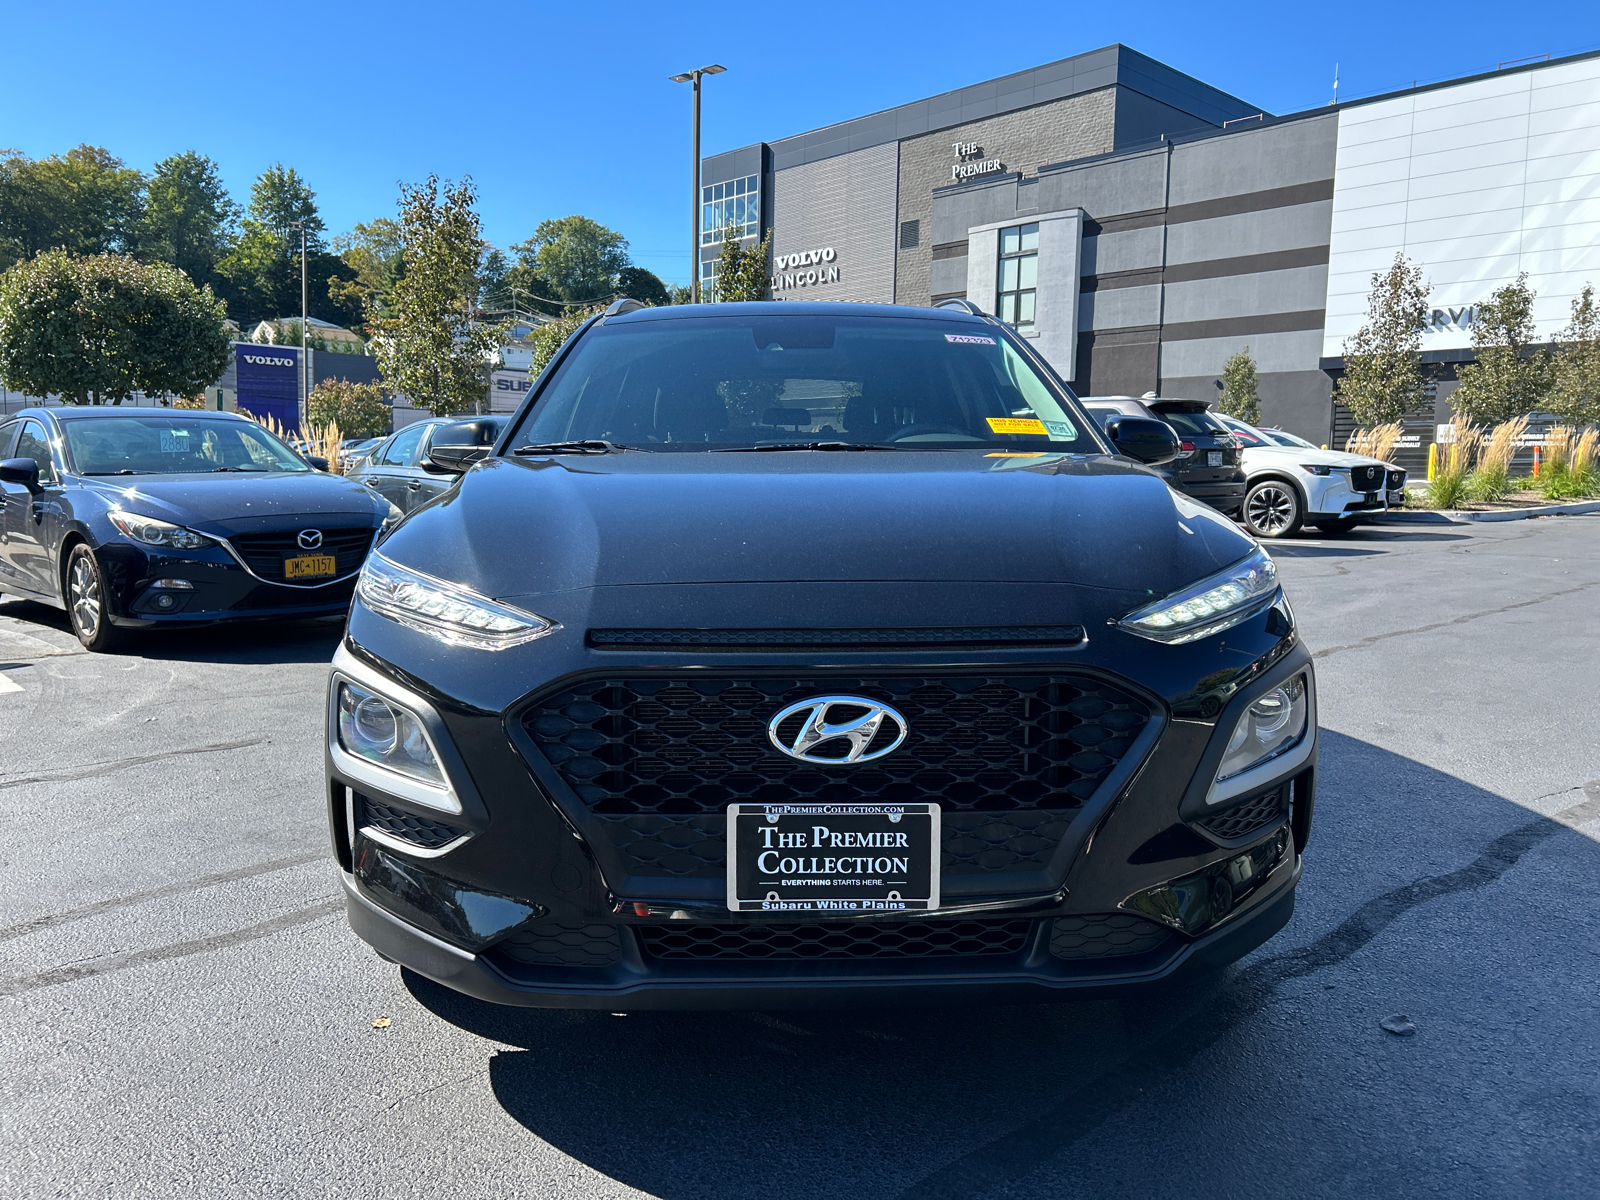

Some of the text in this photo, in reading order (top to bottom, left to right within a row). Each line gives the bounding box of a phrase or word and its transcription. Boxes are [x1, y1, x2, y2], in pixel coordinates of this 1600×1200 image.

[952, 142, 978, 157] THE
[951, 159, 1001, 180] PREMIER
[774, 247, 835, 269] VOLVO
[771, 266, 838, 289] LINCOLN
[243, 355, 294, 367] VOLVO
[162, 437, 189, 451] 2880
[312, 558, 332, 572] 1157
[757, 826, 909, 848] THE PREMIER
[757, 850, 909, 874] COLLECTION
[762, 901, 906, 910] Subaru White Plains
